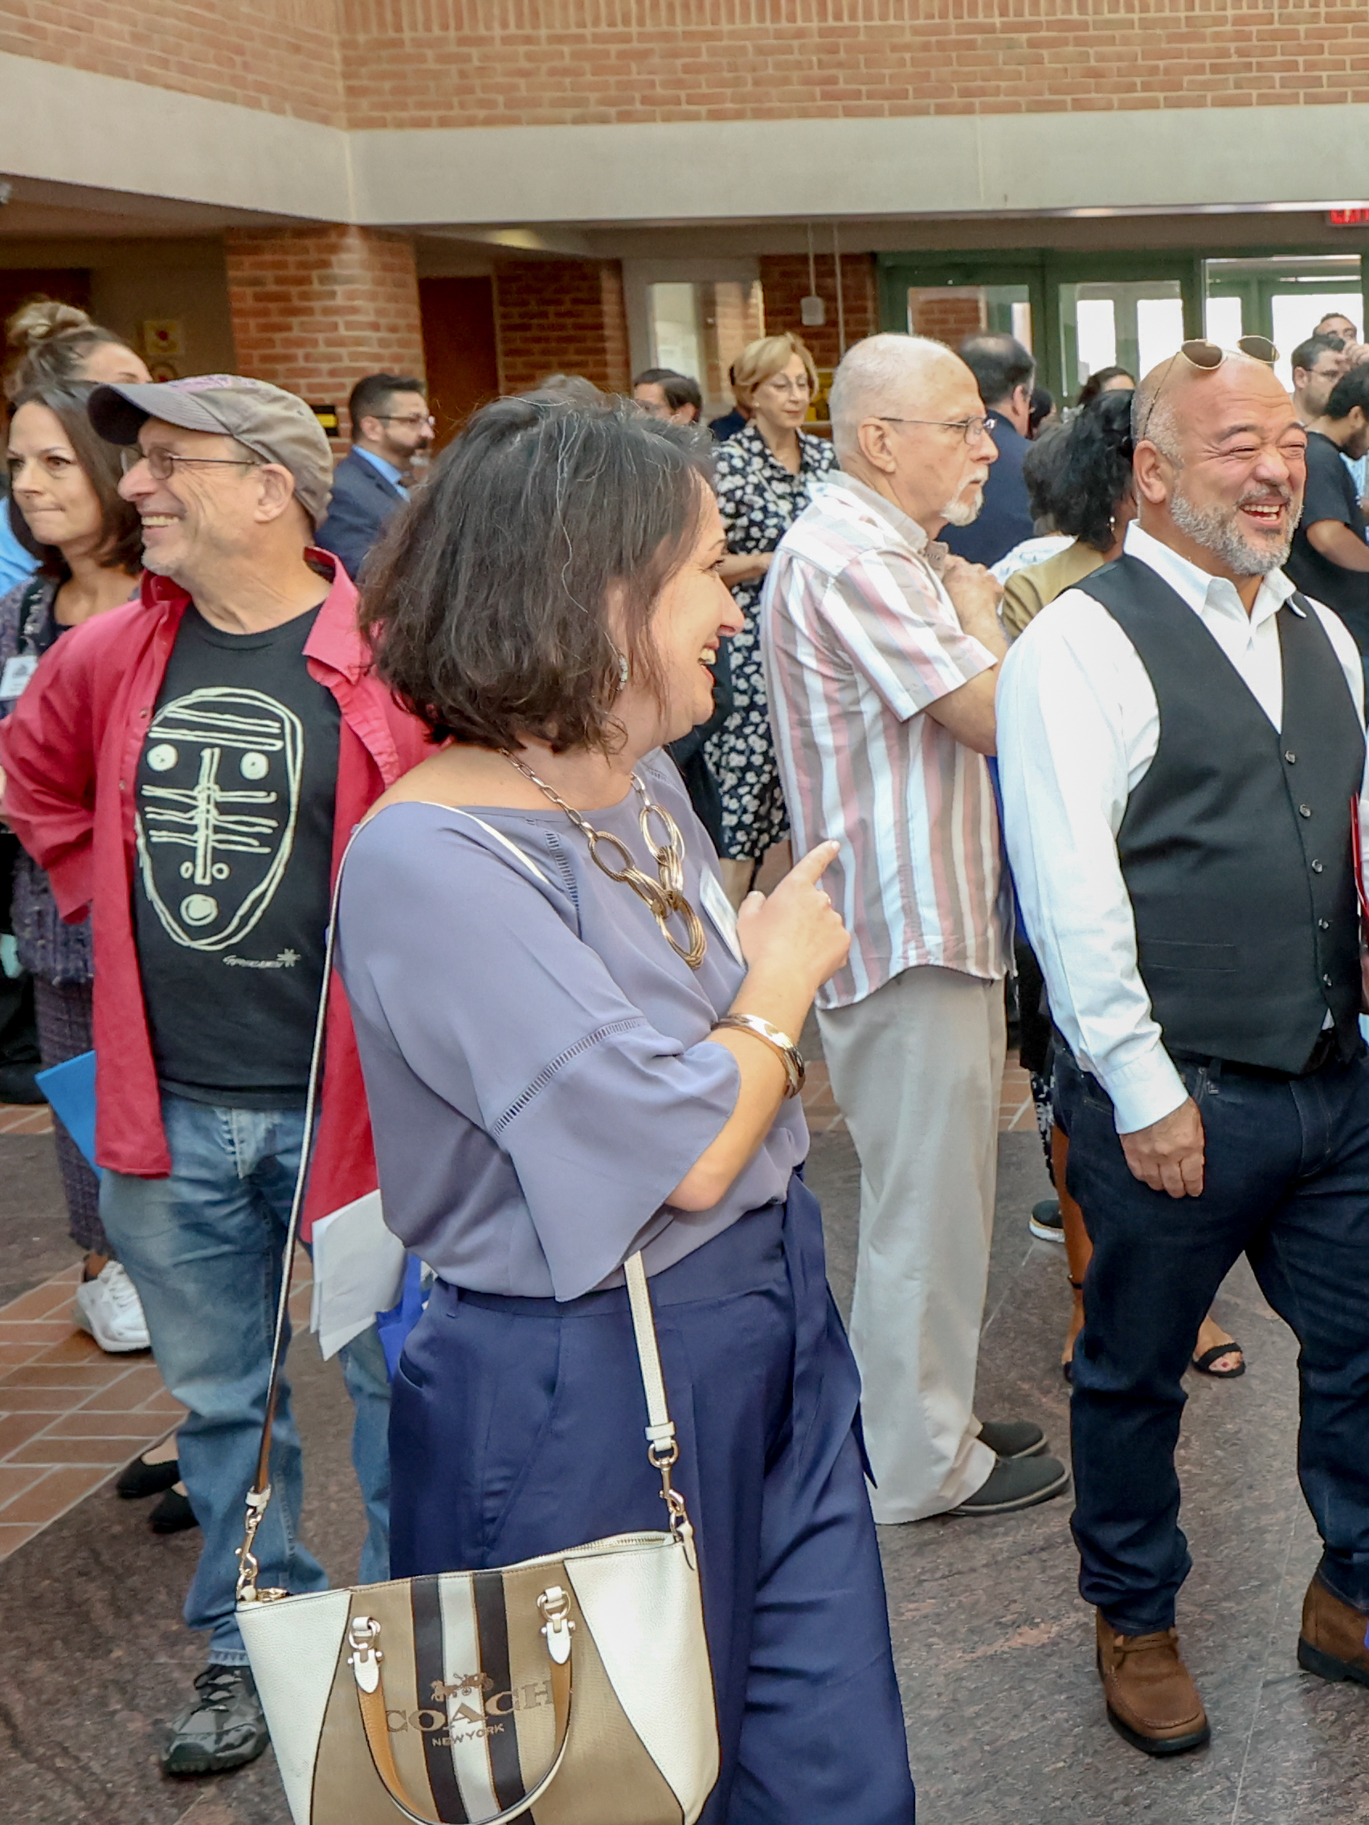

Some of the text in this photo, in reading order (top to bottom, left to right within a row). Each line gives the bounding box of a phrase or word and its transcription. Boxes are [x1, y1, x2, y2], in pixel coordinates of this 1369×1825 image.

[386, 1680, 553, 1733] COACH
[432, 1723, 504, 1747] NEW YORK
